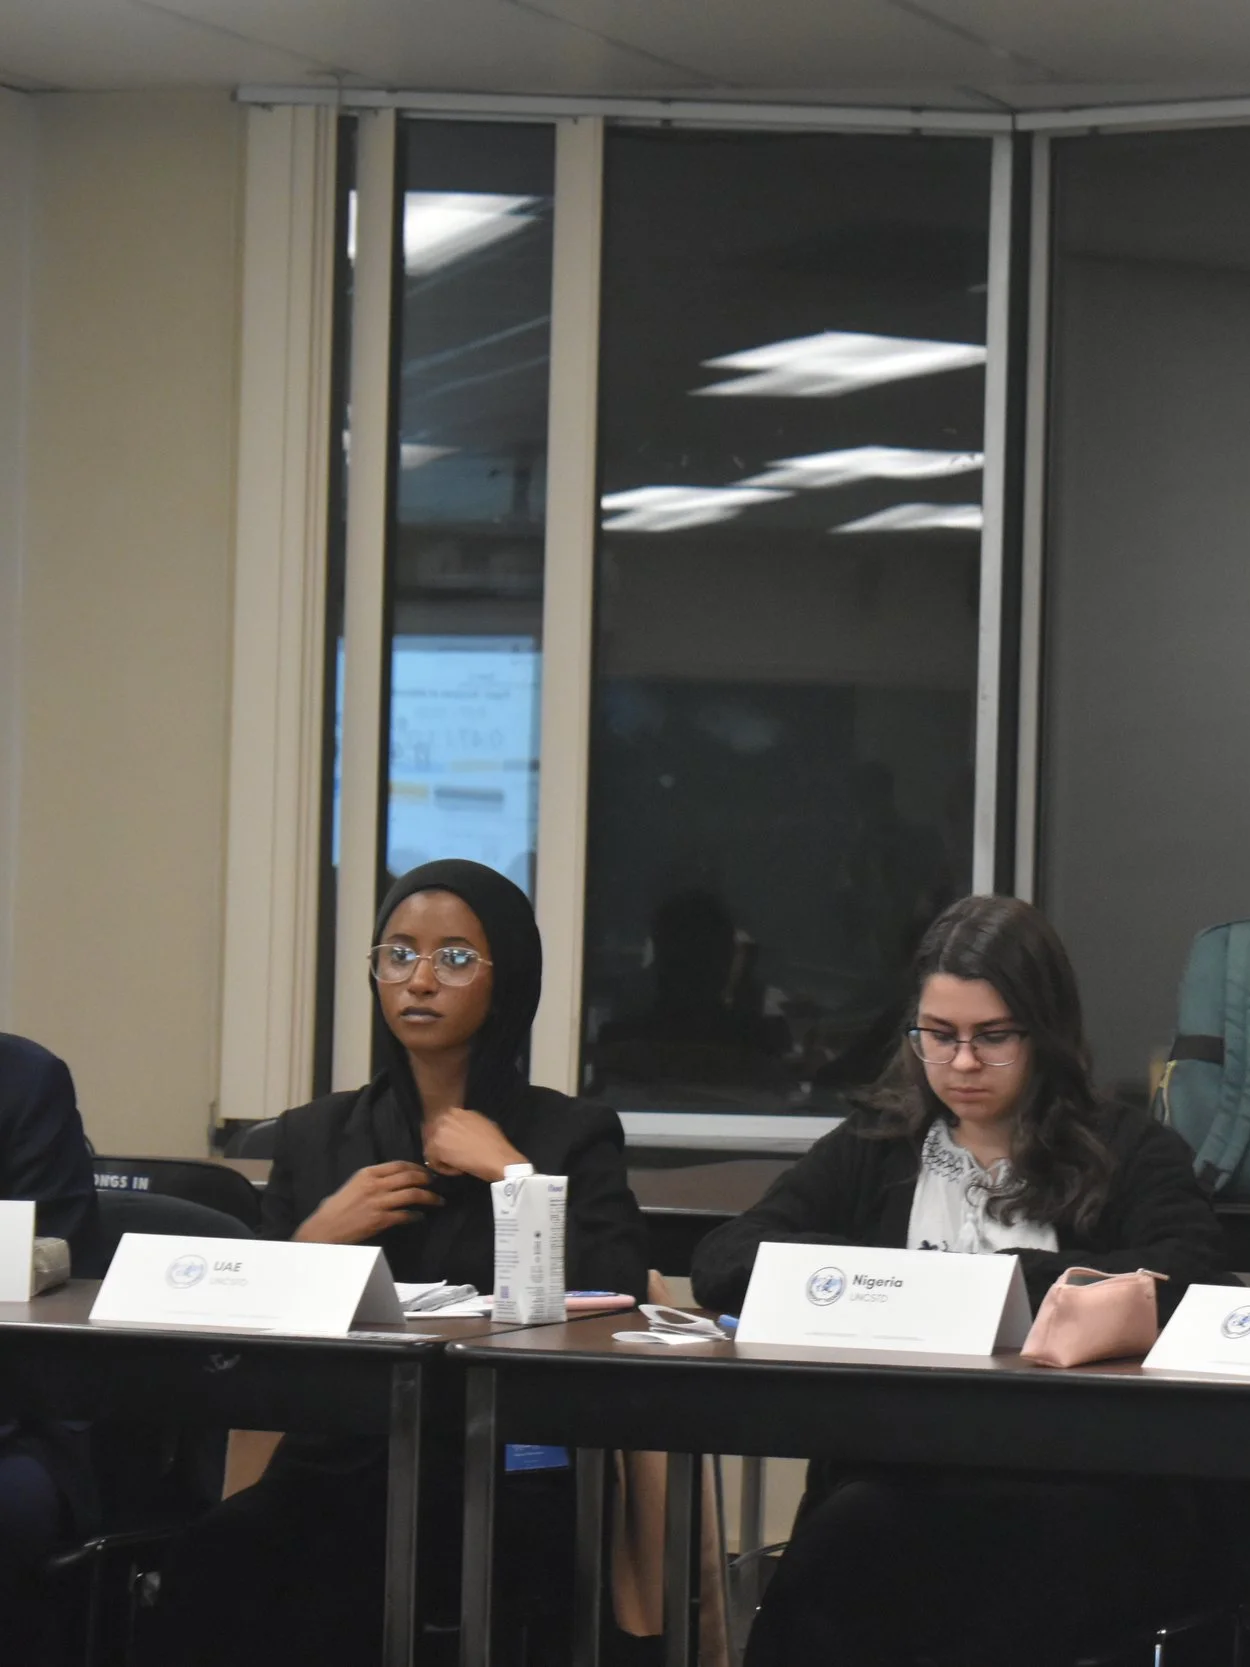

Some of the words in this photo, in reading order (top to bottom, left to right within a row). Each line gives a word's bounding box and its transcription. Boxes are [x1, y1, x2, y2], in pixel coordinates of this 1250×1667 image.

[132, 1176, 149, 1190] IN
[212, 1260, 243, 1273] UAE
[852, 1274, 904, 1290] Nigeria
